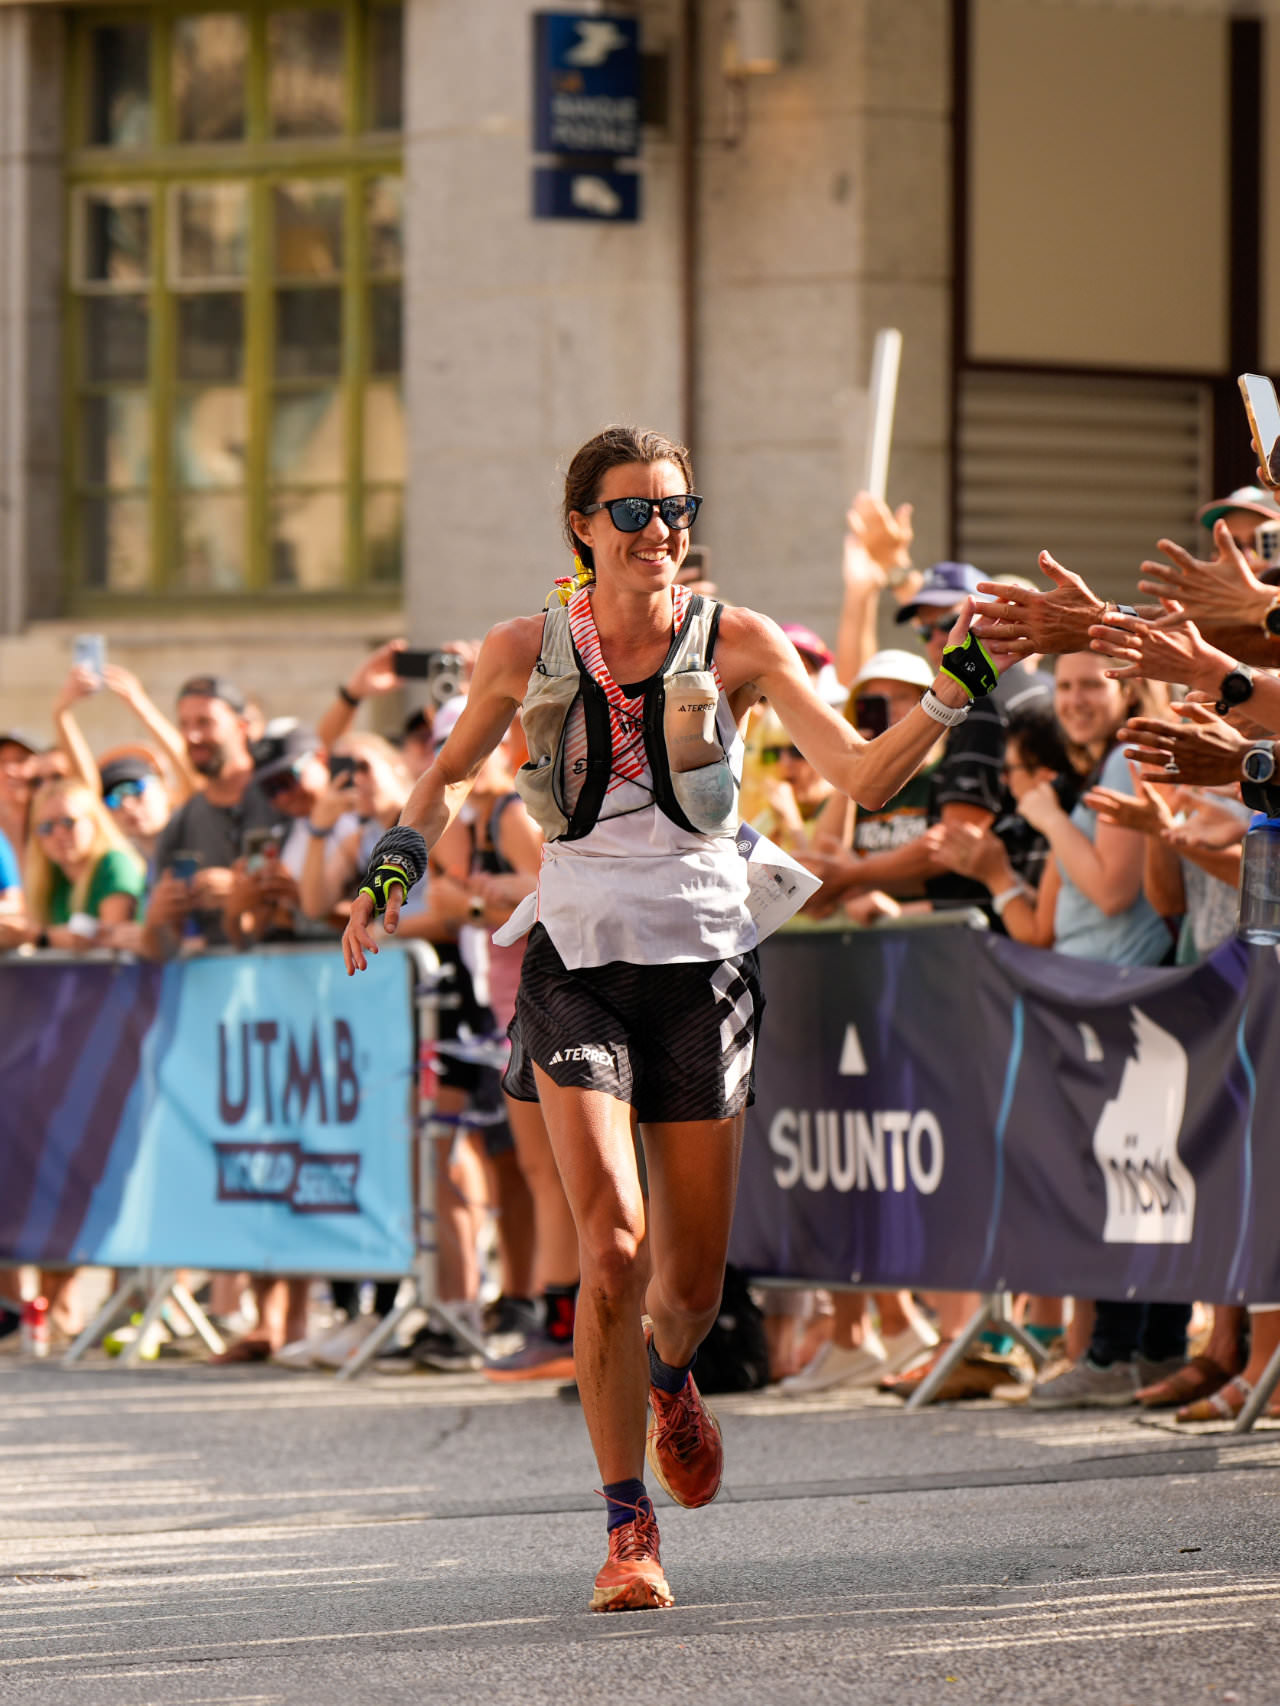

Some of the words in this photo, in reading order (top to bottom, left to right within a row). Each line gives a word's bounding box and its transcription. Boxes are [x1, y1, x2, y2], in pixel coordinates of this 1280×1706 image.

[218, 1017, 360, 1126] UTMB
[563, 1047, 616, 1067] TERREX
[769, 1108, 944, 1196] SUUNTO
